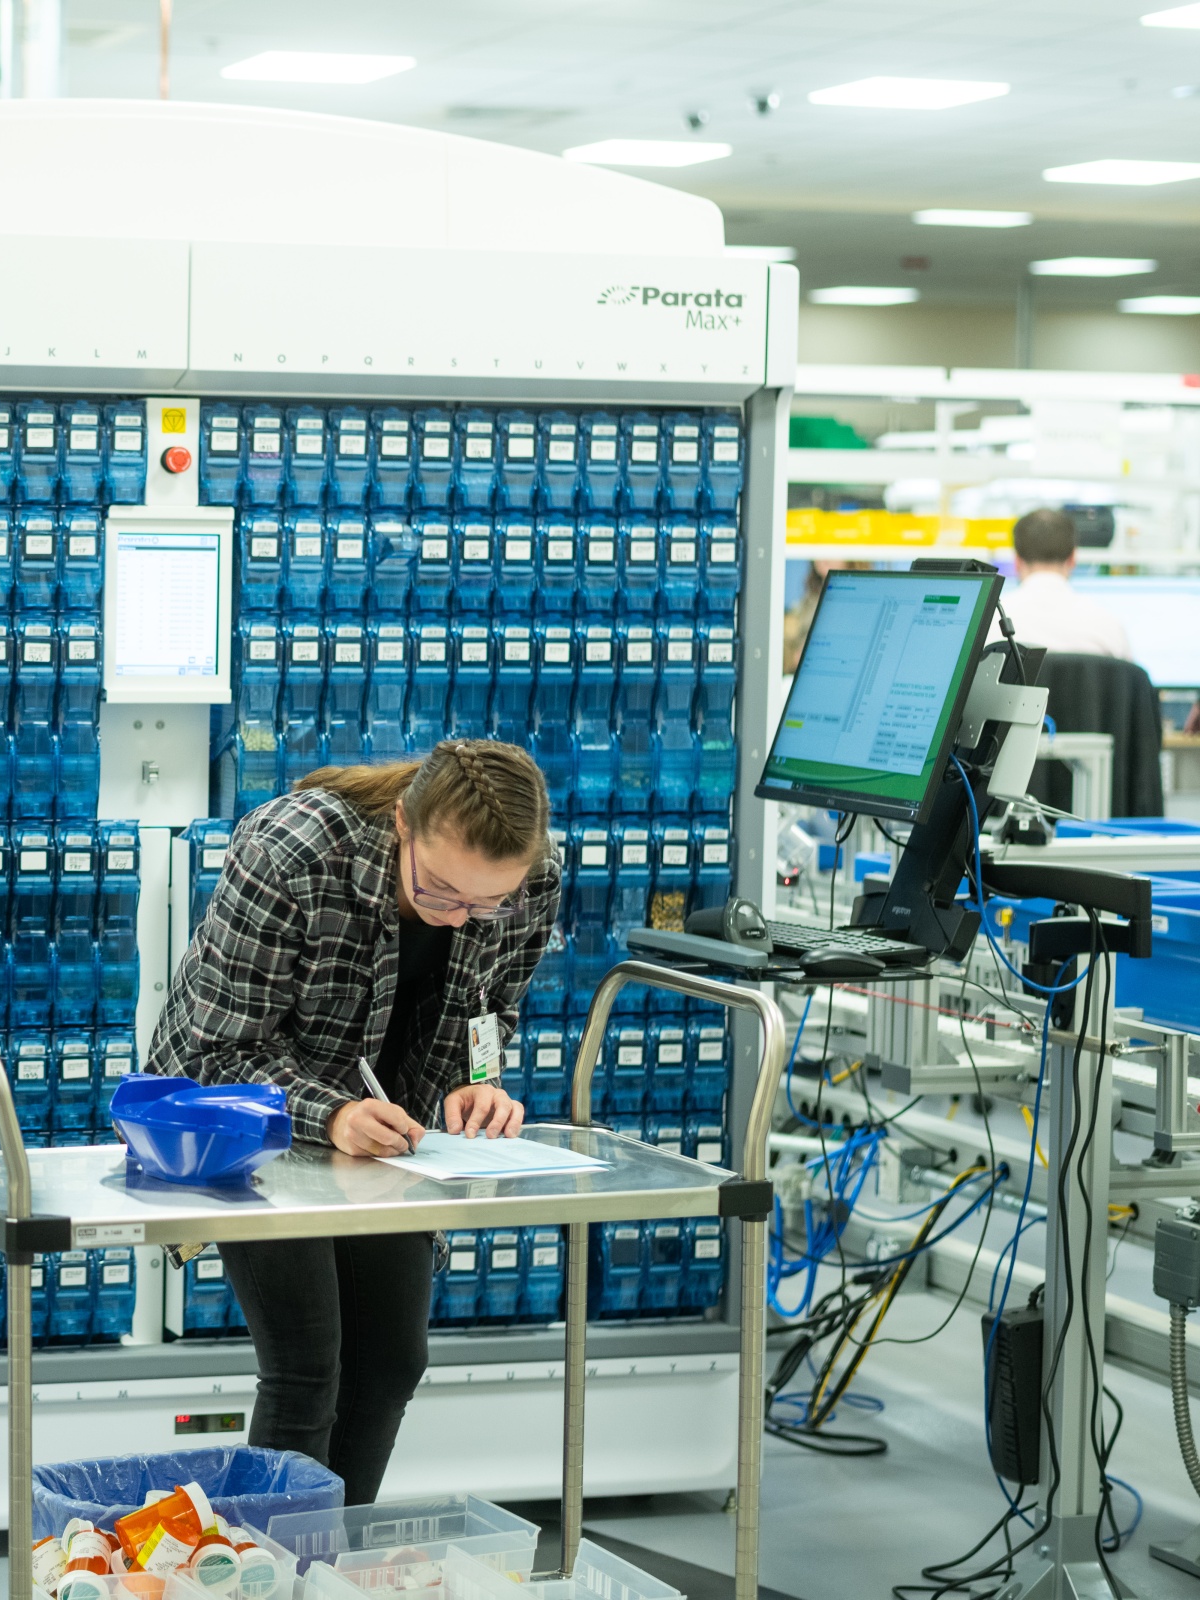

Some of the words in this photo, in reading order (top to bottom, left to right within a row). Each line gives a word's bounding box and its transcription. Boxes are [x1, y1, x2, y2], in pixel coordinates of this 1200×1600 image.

[642, 287, 743, 308] Parata
[6, 347, 10, 356] J
[49, 348, 55, 356] K
[95, 349, 100, 358] L
[137, 350, 146, 358] M
[234, 354, 242, 362] N
[278, 354, 286, 363] O
[322, 355, 328, 363] P
[364, 356, 372, 365] Q
[408, 357, 414, 365] R
[452, 358, 457, 367] S
[494, 359, 499, 367] T
[535, 361, 542, 369] U
[743, 366, 748, 374] Z
[213, 1385, 221, 1393] N
[425, 1375, 431, 1384] S
[466, 1373, 472, 1382] T
[507, 1371, 514, 1381] U
[548, 1370, 555, 1379] V
[587, 1367, 598, 1376] W
[630, 1365, 637, 1375] X
[670, 1363, 676, 1372] Y
[710, 1361, 716, 1370] Z
[32, 1393, 39, 1402] K
[77, 1391, 82, 1399] L
[118, 1390, 128, 1399] M
